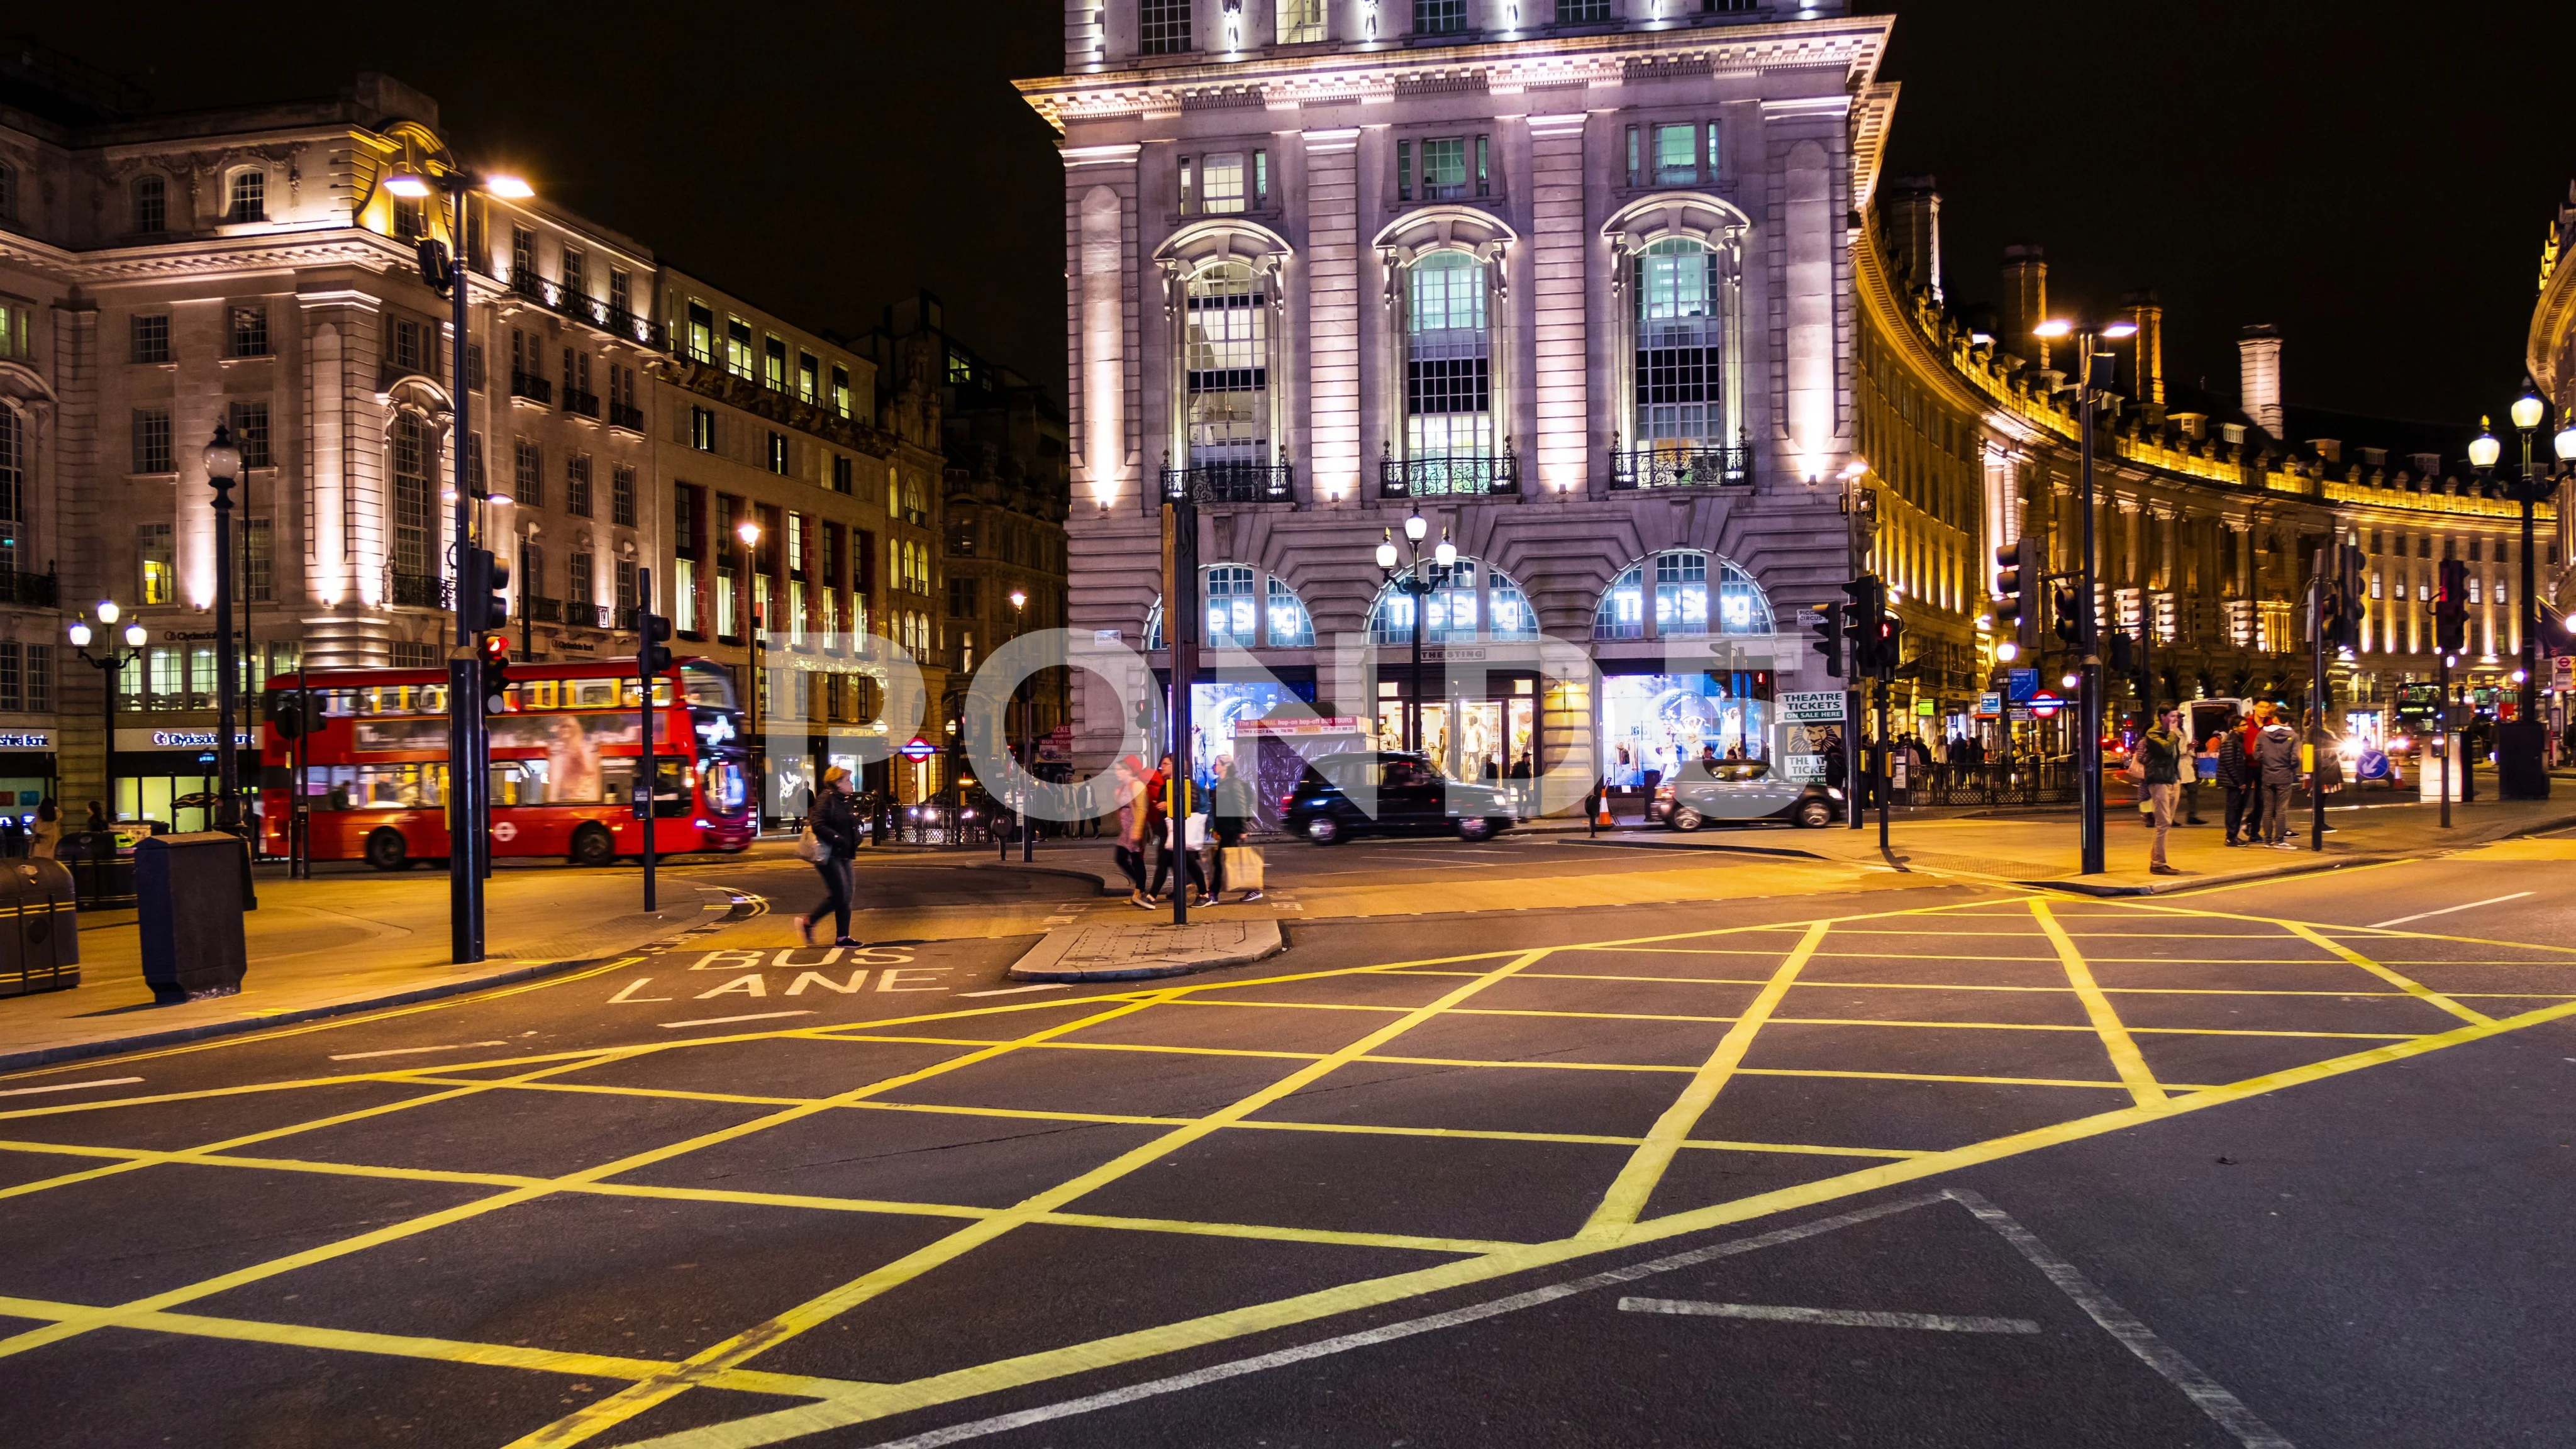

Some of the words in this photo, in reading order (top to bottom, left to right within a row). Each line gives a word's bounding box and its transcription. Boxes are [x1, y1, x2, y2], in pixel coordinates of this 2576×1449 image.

[1784, 693, 1842, 702] THEATRE
[1787, 701, 1841, 710] TICKETS
[688, 946, 915, 970] BUS
[606, 967, 954, 1004] LANE
